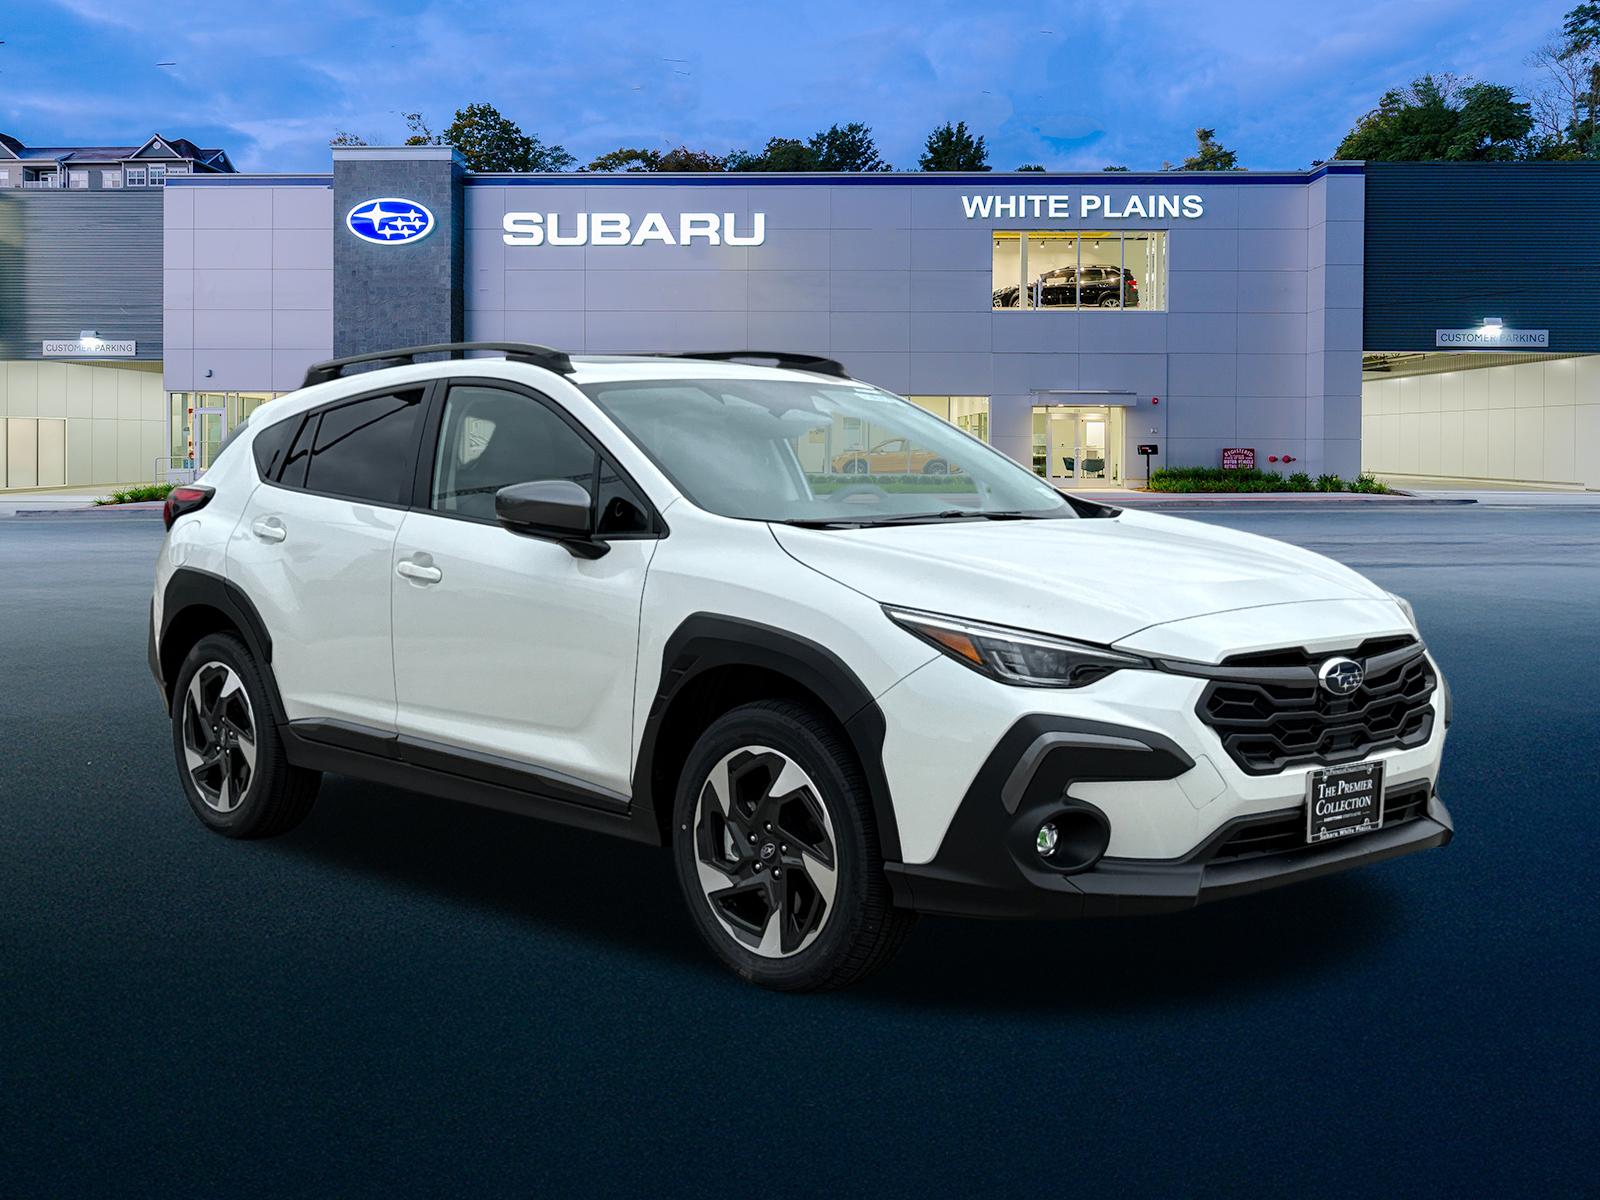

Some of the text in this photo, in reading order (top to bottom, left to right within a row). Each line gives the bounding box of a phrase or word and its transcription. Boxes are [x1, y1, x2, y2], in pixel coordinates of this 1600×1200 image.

[961, 195, 1204, 218] WHITE PLAINS
[502, 212, 766, 246] SUBARU
[1440, 333, 1545, 342] CUSTOMER PARKING
[95, 344, 133, 352] PARKING
[1317, 779, 1373, 799] THE PREMIER
[1315, 795, 1373, 816] COLLECTION
